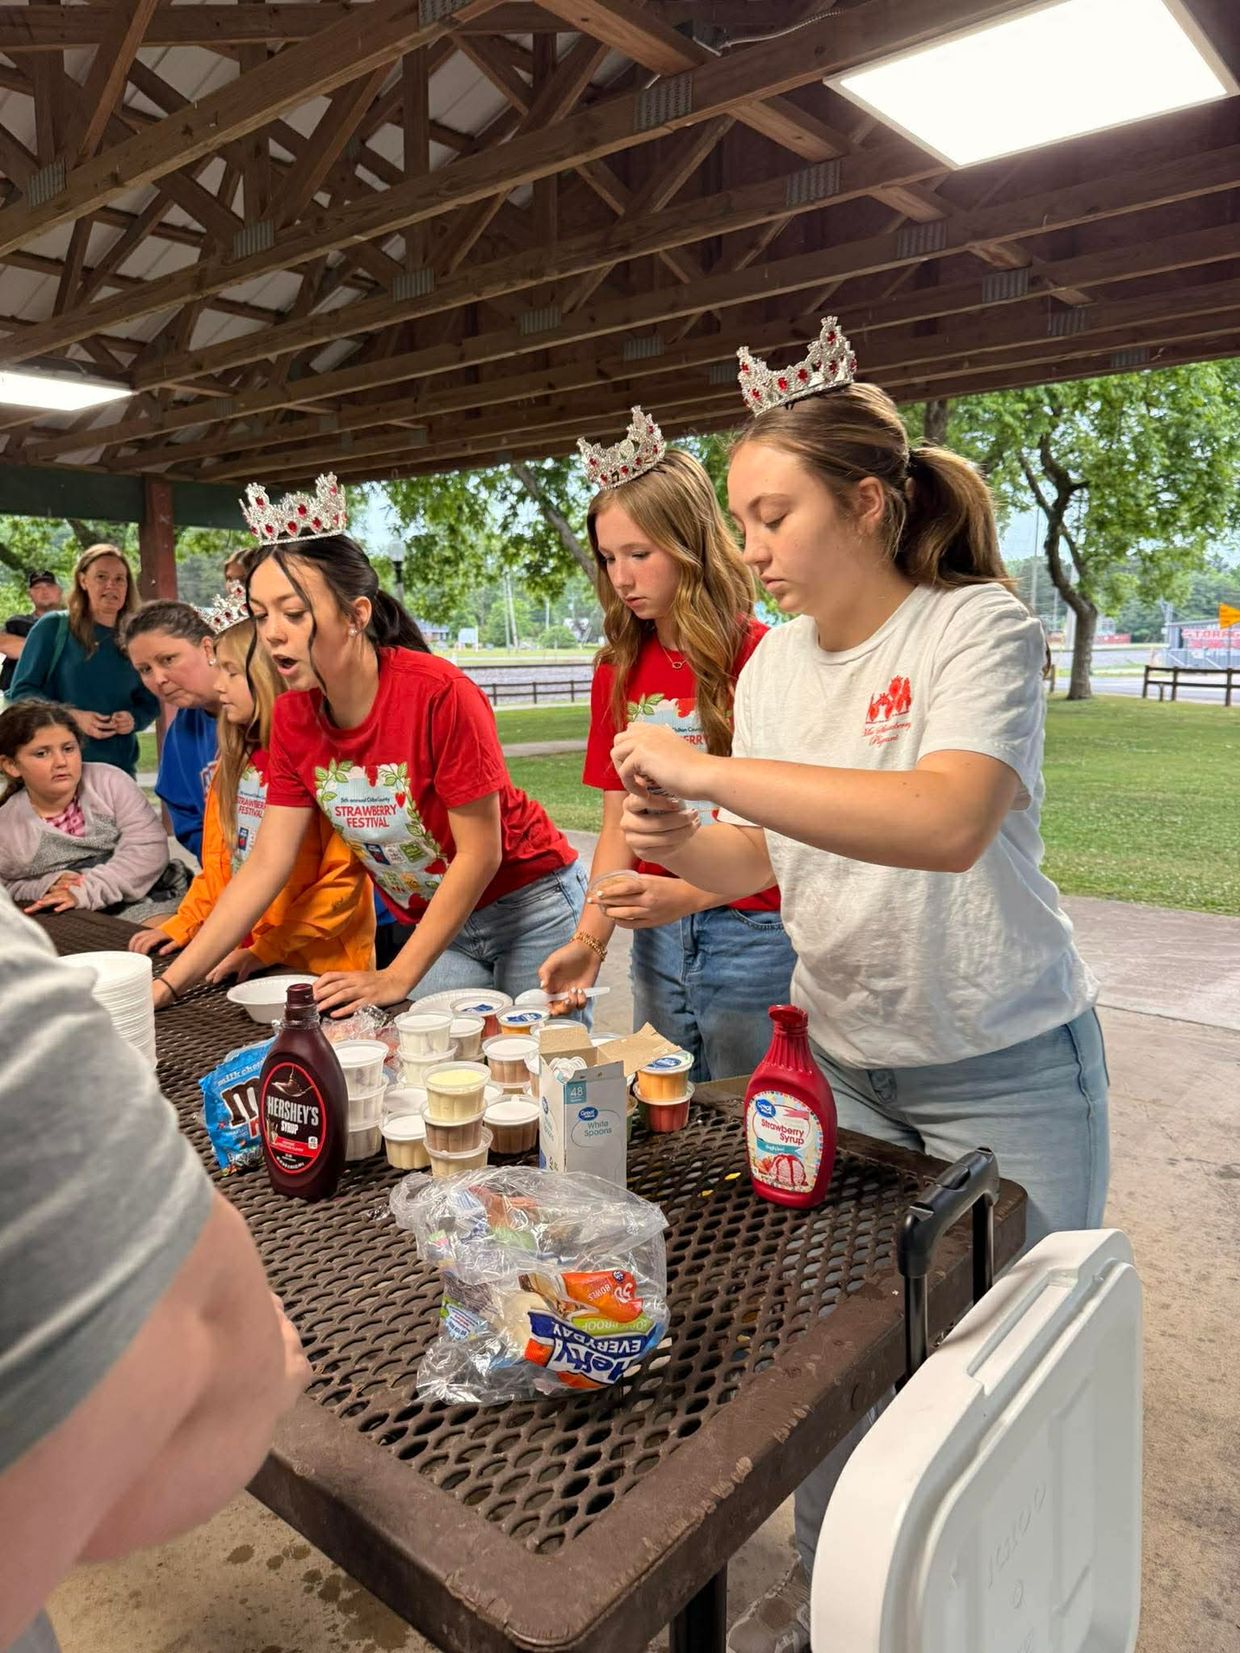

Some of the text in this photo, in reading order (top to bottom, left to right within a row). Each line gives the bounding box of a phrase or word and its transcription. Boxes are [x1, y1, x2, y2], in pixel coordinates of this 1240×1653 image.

[335, 804, 397, 817] STRAWBERRY
[347, 817, 390, 829] FESTIVAL
[570, 1086, 583, 1097] 48
[267, 1095, 319, 1126] HERSHEY'S
[281, 1120, 299, 1135] SYRUP
[587, 1120, 609, 1129] White
[761, 1118, 805, 1136] Strawberry
[584, 1127, 612, 1137] Spoons
[780, 1132, 805, 1145] Syrup
[588, 1284, 611, 1301] BOWLS
[553, 1323, 642, 1353] EVERYDAY
